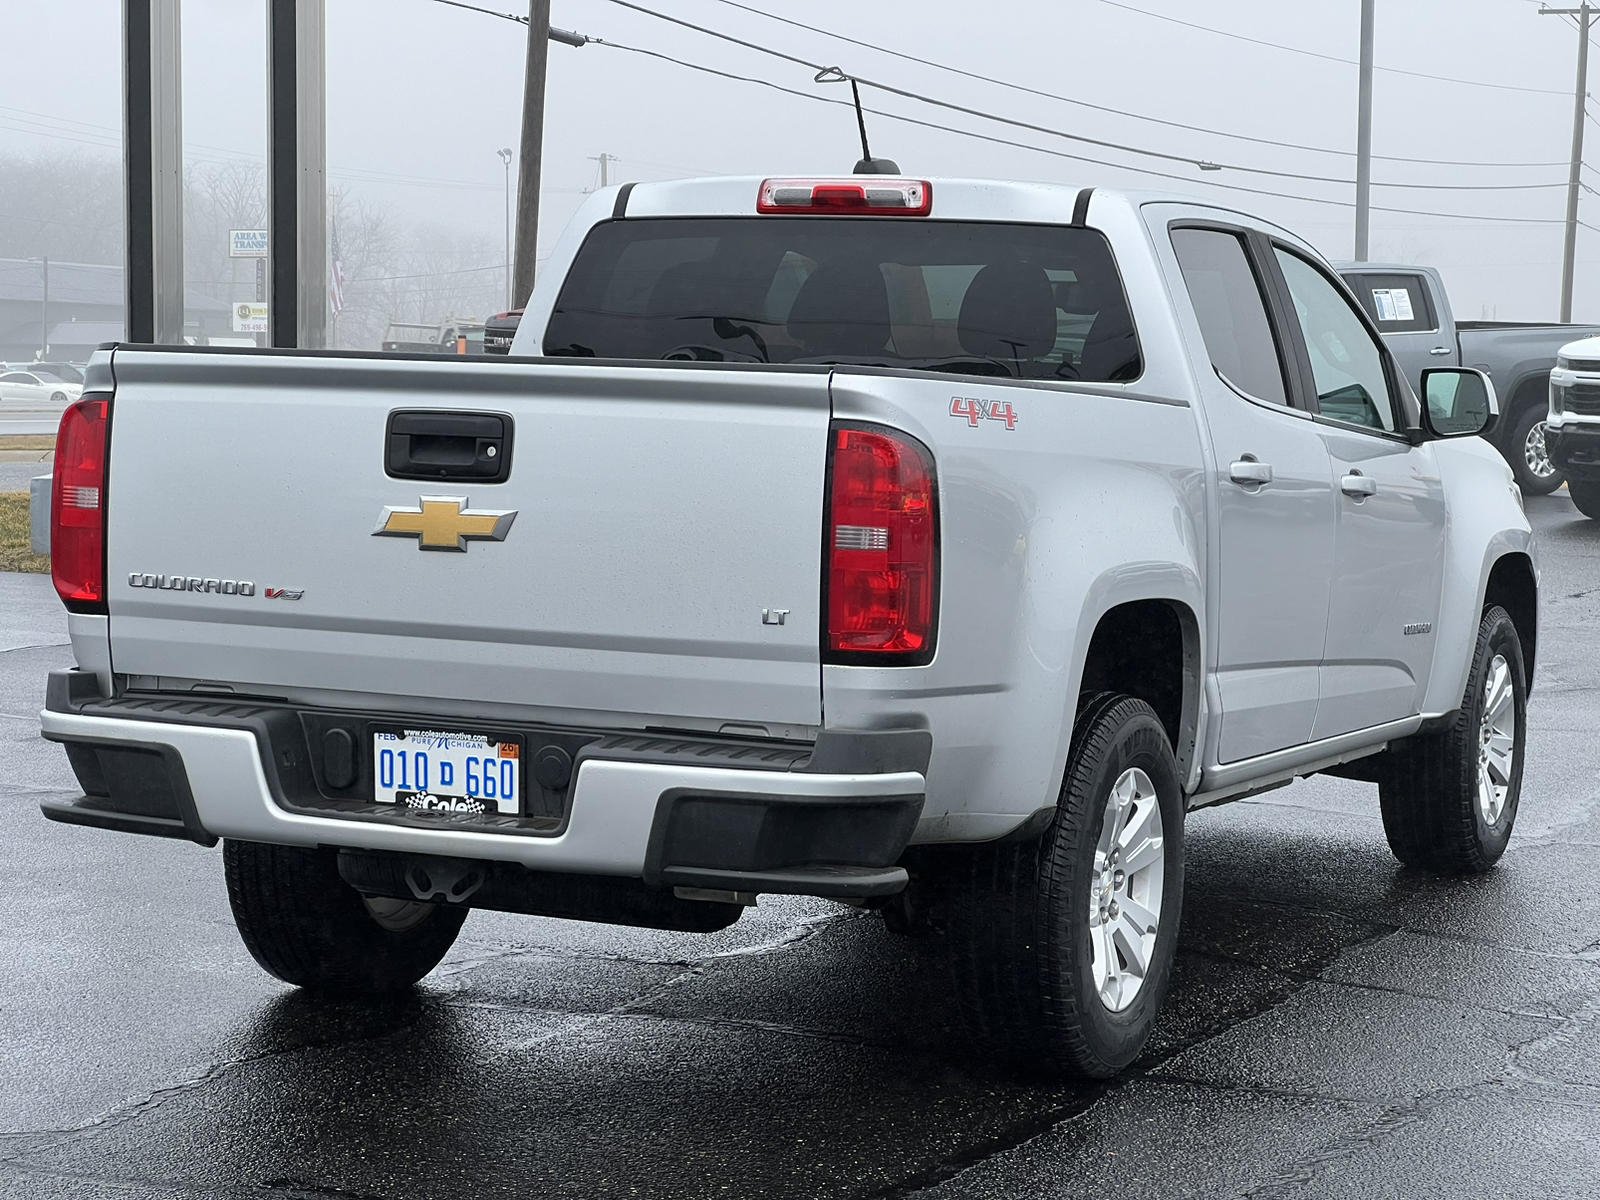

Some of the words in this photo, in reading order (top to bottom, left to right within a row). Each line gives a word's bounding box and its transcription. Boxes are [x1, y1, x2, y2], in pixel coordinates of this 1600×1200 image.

[234, 232, 257, 240] AREA
[234, 240, 267, 248] TRANSP
[128, 572, 255, 597] COLORADO
[762, 608, 790, 626] LT
[378, 732, 397, 741] FEB
[403, 729, 488, 743] www.coleautomotive.com
[411, 737, 431, 746] PURE
[428, 736, 484, 751] MICHIGAN
[501, 742, 514, 752] 26
[380, 749, 428, 791] 010
[440, 761, 454, 786] D
[466, 756, 514, 800] 660
[422, 794, 468, 812] Cole
